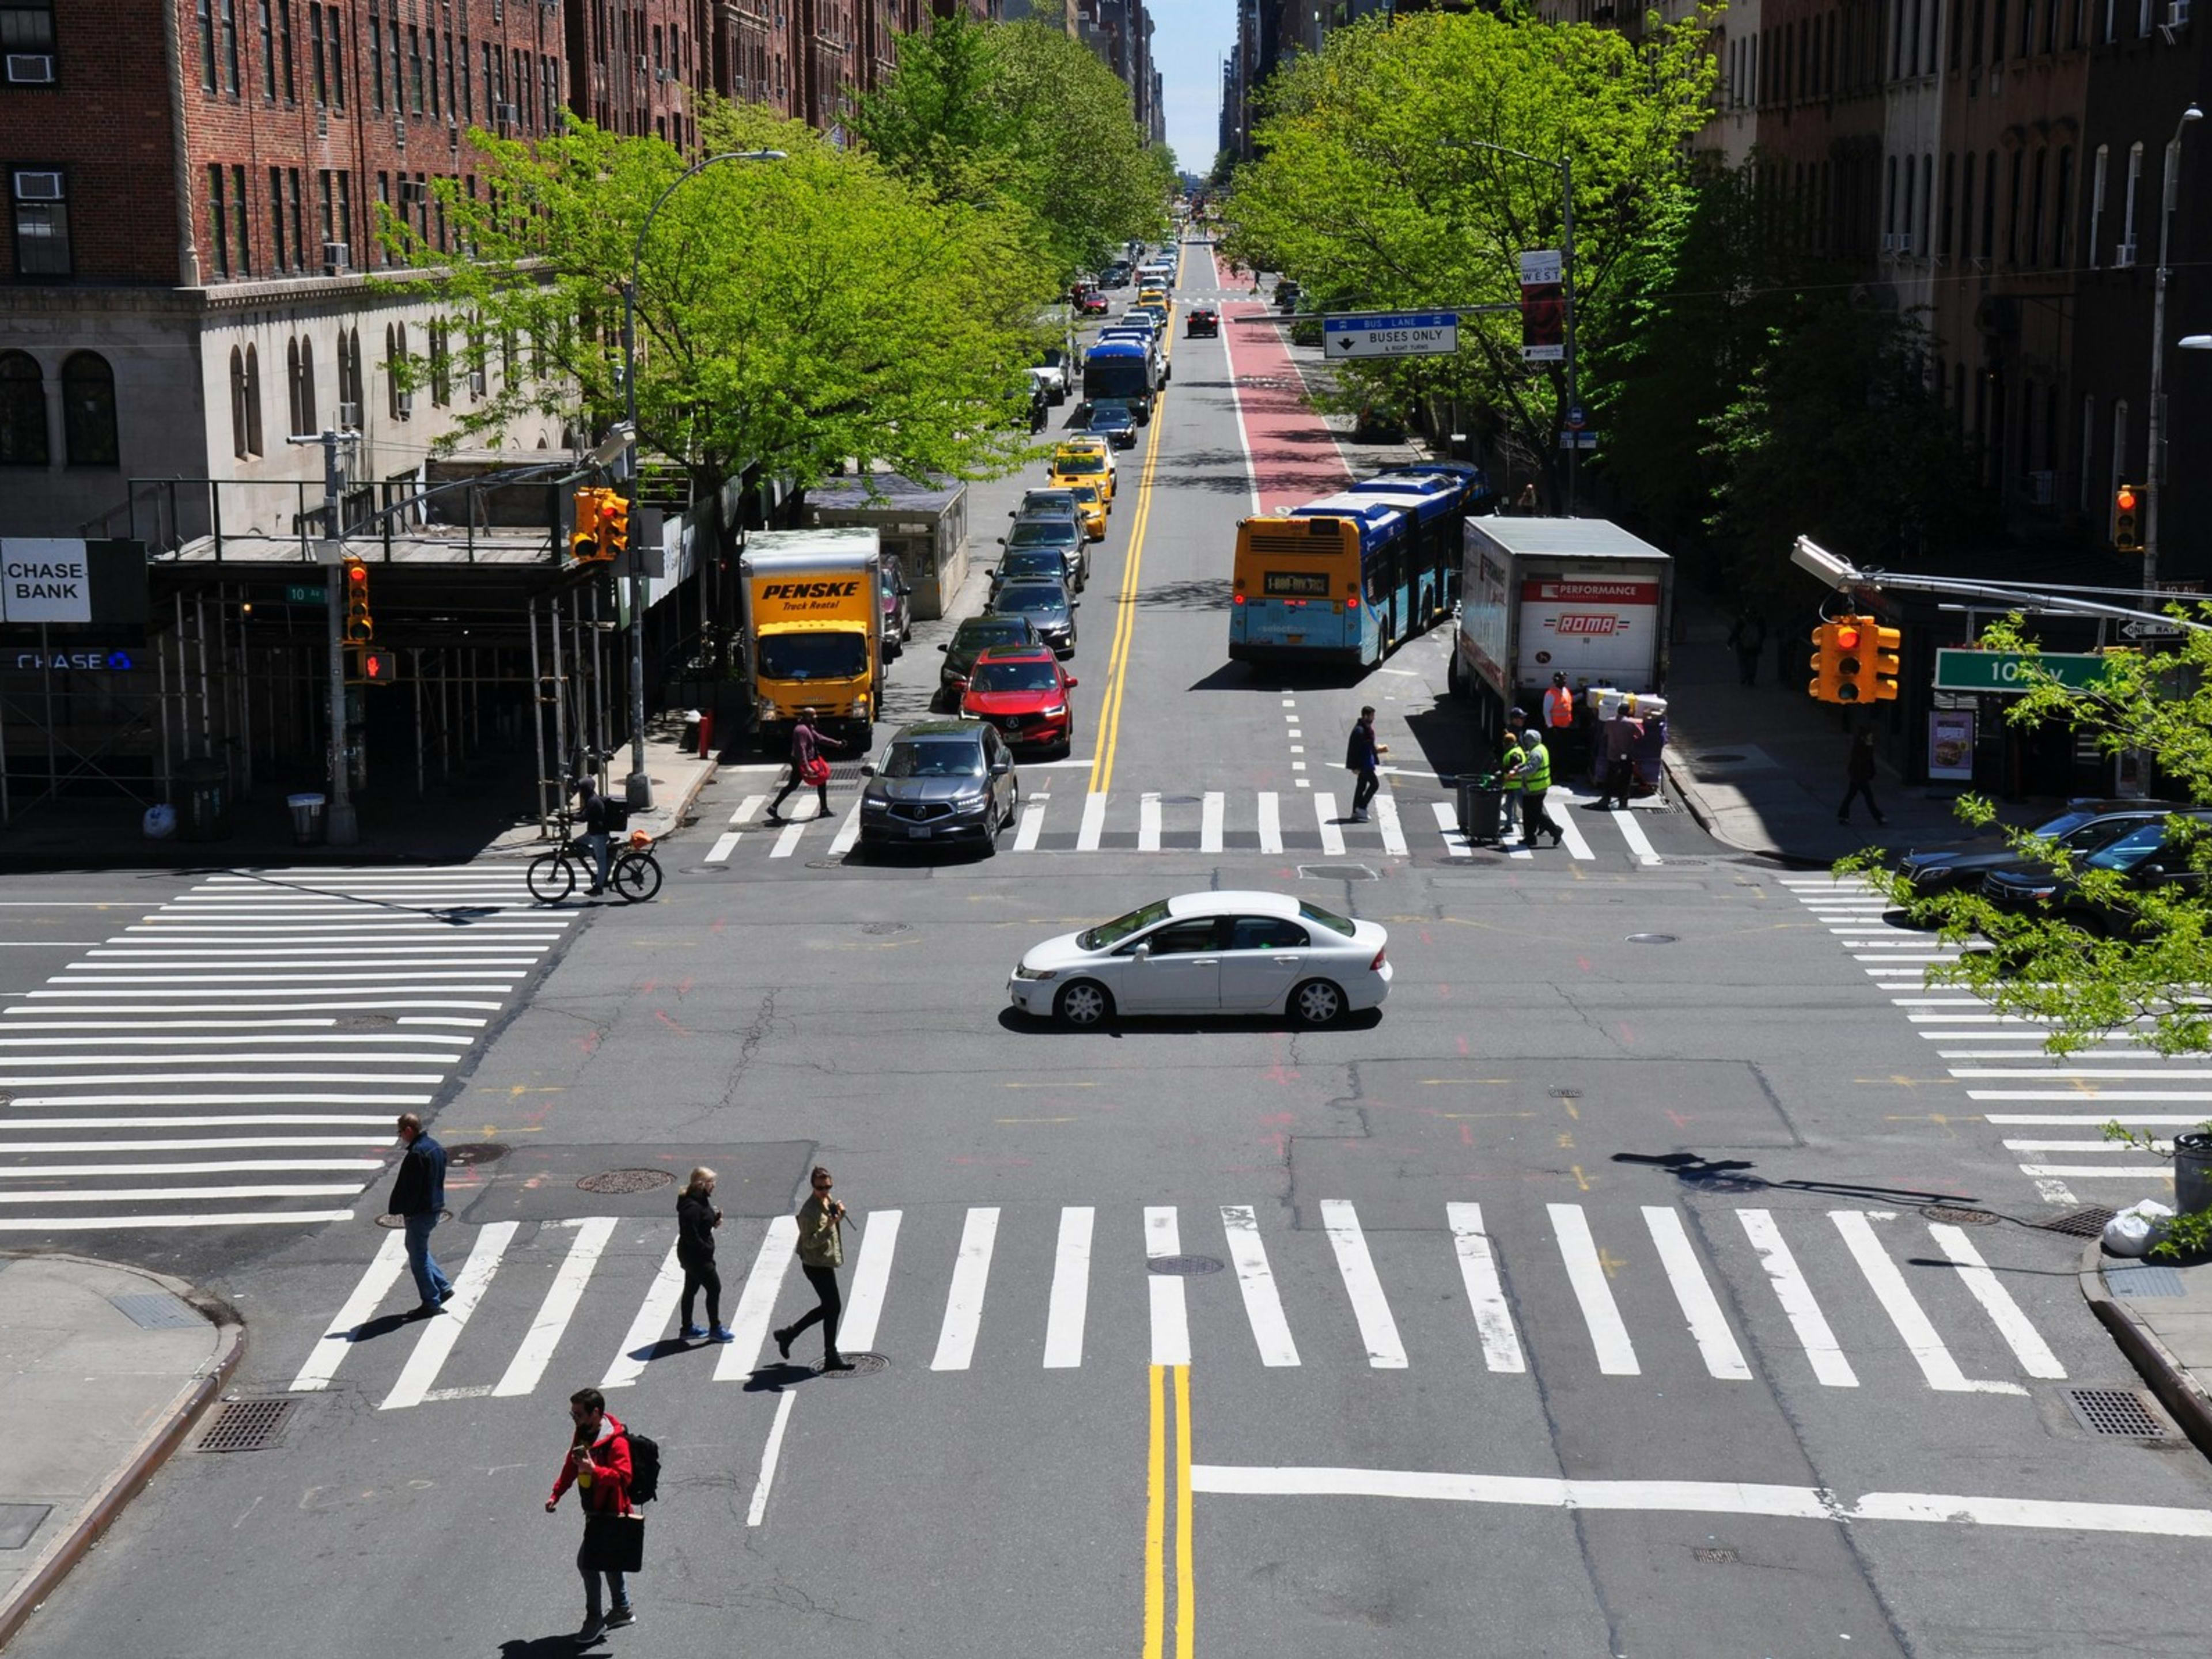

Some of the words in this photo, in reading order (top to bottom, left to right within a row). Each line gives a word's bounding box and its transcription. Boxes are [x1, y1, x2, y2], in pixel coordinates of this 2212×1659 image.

[1522, 271, 1559, 281] WEST
[1364, 320, 1382, 328] BUS
[1392, 318, 1416, 327] LANE
[1369, 331, 1408, 343] BUSES
[1412, 329, 1442, 341] ONLY
[7, 563, 82, 578] CHASE
[16, 584, 78, 599] BANK
[291, 588, 305, 600] 10
[762, 581, 859, 600] PENSKE
[1560, 585, 1636, 595] PERFORMANCE
[783, 602, 807, 611] Truck
[809, 600, 840, 610] Rental
[1560, 616, 1613, 632] ROMA
[2128, 626, 2144, 634] ONE
[17, 654, 102, 669] CHASE
[1992, 661, 2018, 682] 10
